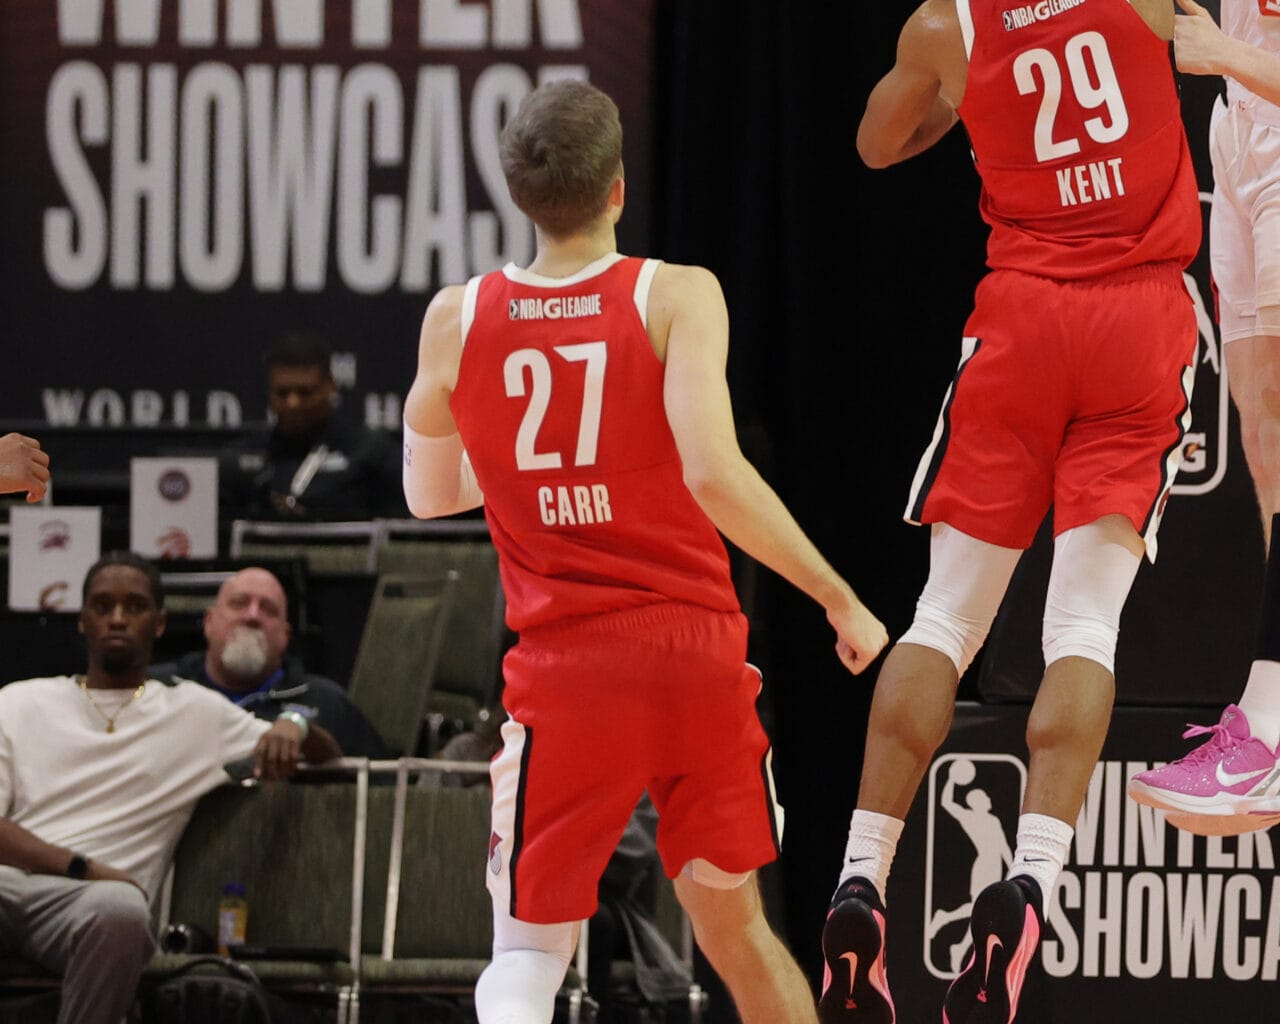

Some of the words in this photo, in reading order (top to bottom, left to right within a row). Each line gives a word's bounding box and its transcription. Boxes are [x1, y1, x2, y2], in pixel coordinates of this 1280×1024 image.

[1013, 31, 1129, 163] 29
[43, 61, 590, 292] SHOWCAS
[1056, 157, 1125, 207] KENT
[503, 341, 607, 471] 27
[538, 484, 613, 526] CARR
